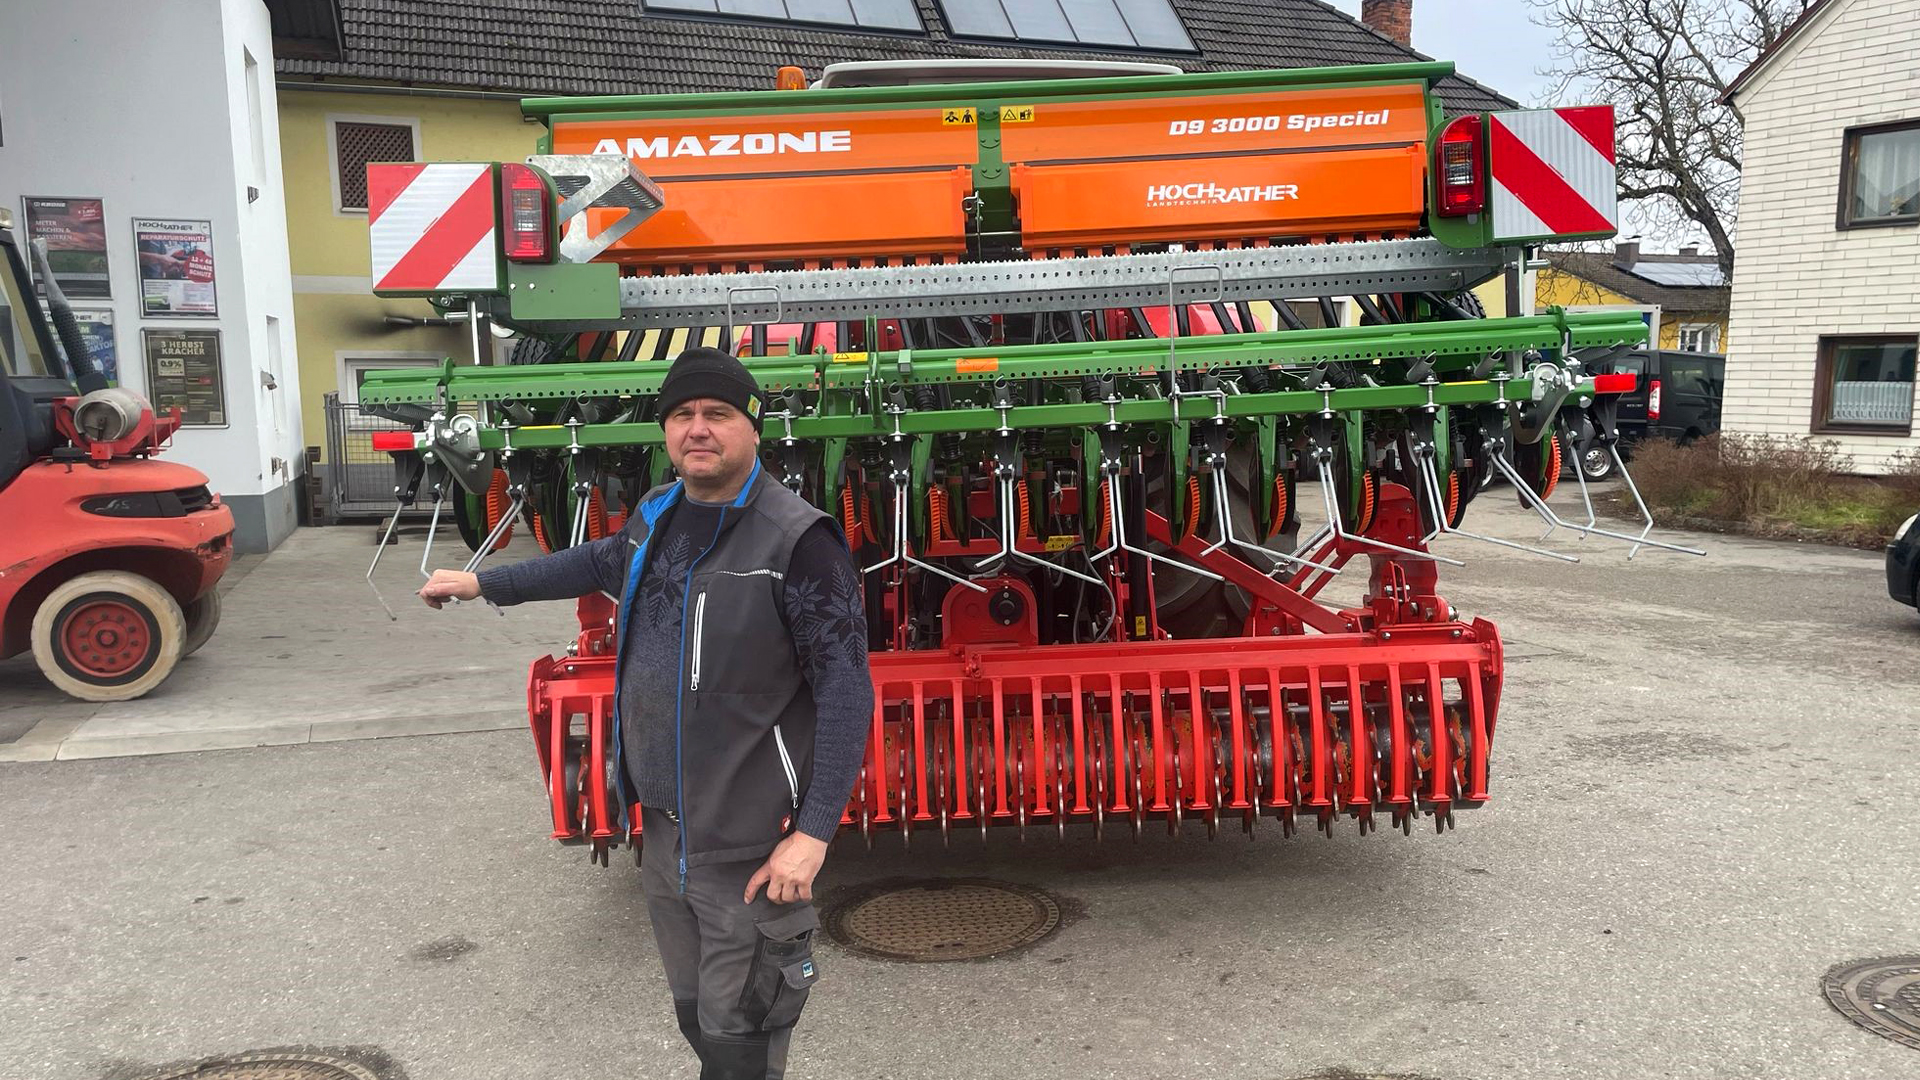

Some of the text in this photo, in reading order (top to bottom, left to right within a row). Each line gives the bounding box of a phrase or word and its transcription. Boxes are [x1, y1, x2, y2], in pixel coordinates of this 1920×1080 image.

[1169, 109, 1389, 136] D9 3000 Special
[591, 130, 851, 159] AMAZONE
[1146, 199, 1218, 208] LANDTECHNIK
[169, 341, 204, 349] HERBST
